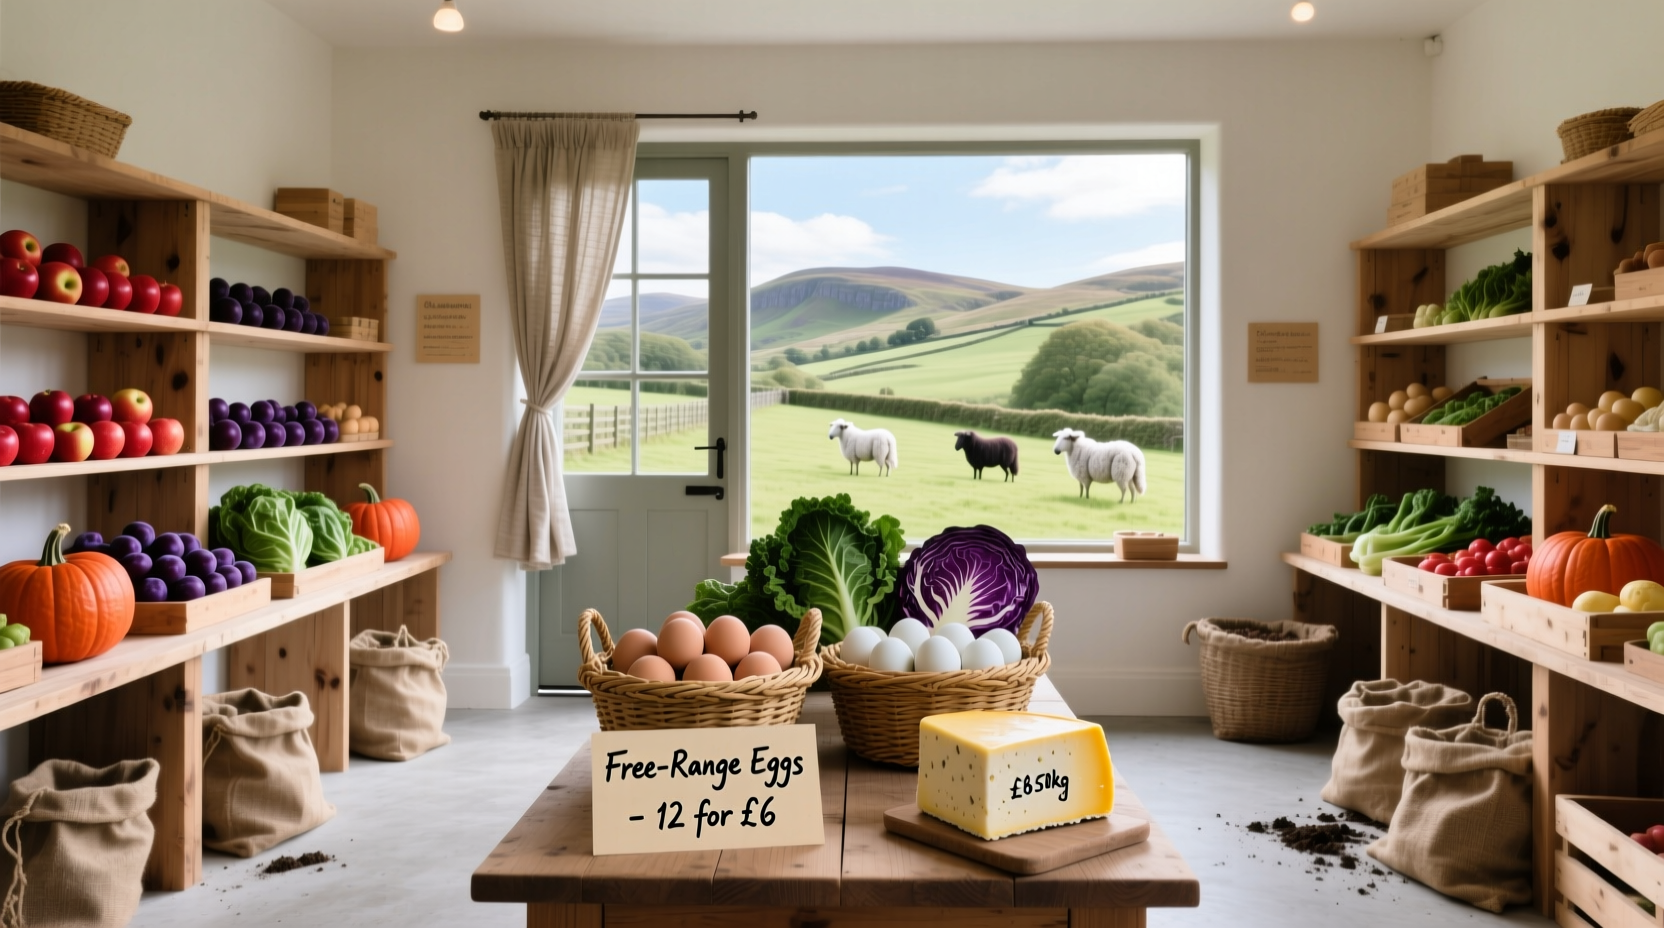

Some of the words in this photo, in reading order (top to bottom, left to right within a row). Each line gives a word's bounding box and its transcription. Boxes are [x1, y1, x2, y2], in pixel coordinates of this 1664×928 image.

[605, 749, 742, 791] Free-Range
[750, 745, 804, 789] Eggs
[657, 800, 685, 831] 12
[693, 798, 734, 839] for
[740, 795, 776, 828] £6
